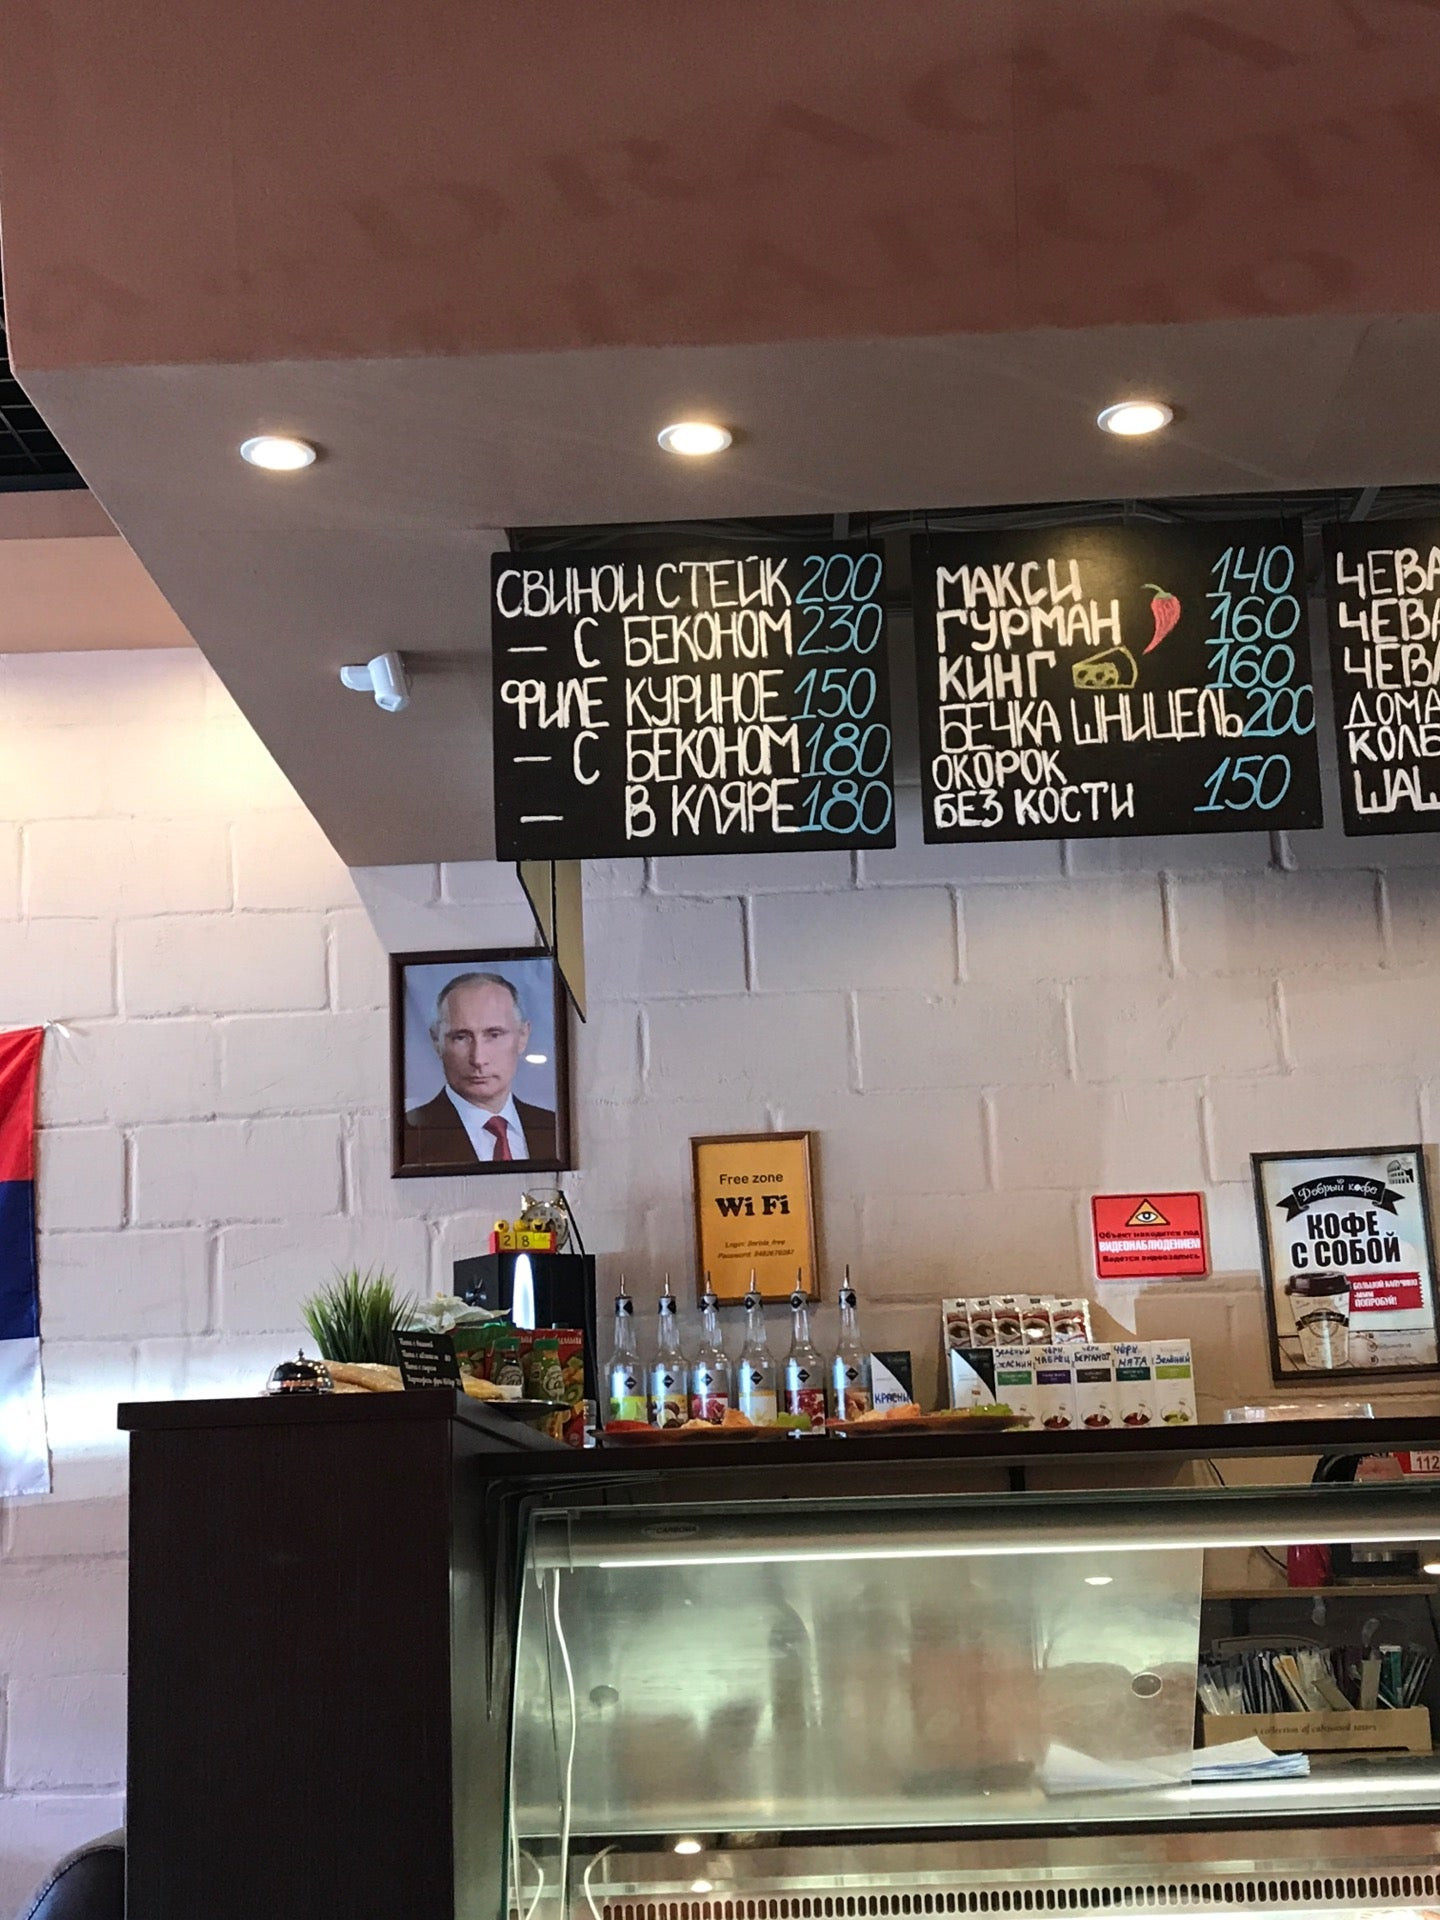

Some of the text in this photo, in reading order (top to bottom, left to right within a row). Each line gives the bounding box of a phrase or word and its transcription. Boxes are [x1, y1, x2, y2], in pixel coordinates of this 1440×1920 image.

[655, 556, 792, 608] СТЕЙК
[796, 553, 883, 604] 200
[937, 545, 1295, 610] МАКСИ 140
[573, 616, 600, 668] С
[623, 609, 793, 667] БЕКОНОМ
[797, 603, 883, 655] 230
[937, 595, 1300, 653] ГУРМАН 160
[938, 644, 1296, 701] КИНГ 160
[500, 667, 877, 730] ФИЛЕ КУРИНОЕ 150
[939, 685, 1316, 754] БЕЧКА ШНИЦЕЛЬ 200
[573, 731, 600, 786] С
[626, 723, 799, 783] БЕКОНОМ
[801, 722, 891, 779] 180
[1348, 723, 1440, 765] КОЛБ
[931, 749, 1068, 792] ОКОРОК
[932, 754, 1291, 829] БЕЗ КОСТИ 150
[625, 784, 656, 840] В
[671, 778, 799, 837] КЛЯРЕ
[796, 779, 891, 834] 180
[719, 1173, 784, 1185] Free zone
[1298, 1179, 1344, 1201] Добрый
[715, 1195, 790, 1217] Wi Fi
[1307, 1211, 1380, 1239] КОФЕ
[1099, 1238, 1201, 1253] ВИДЕОНАБЛЮДЕНИЕМ
[1183, 1229, 1199, 1237] под
[1291, 1231, 1401, 1268] С СОБОЙ
[1416, 1455, 1440, 1470] 112
